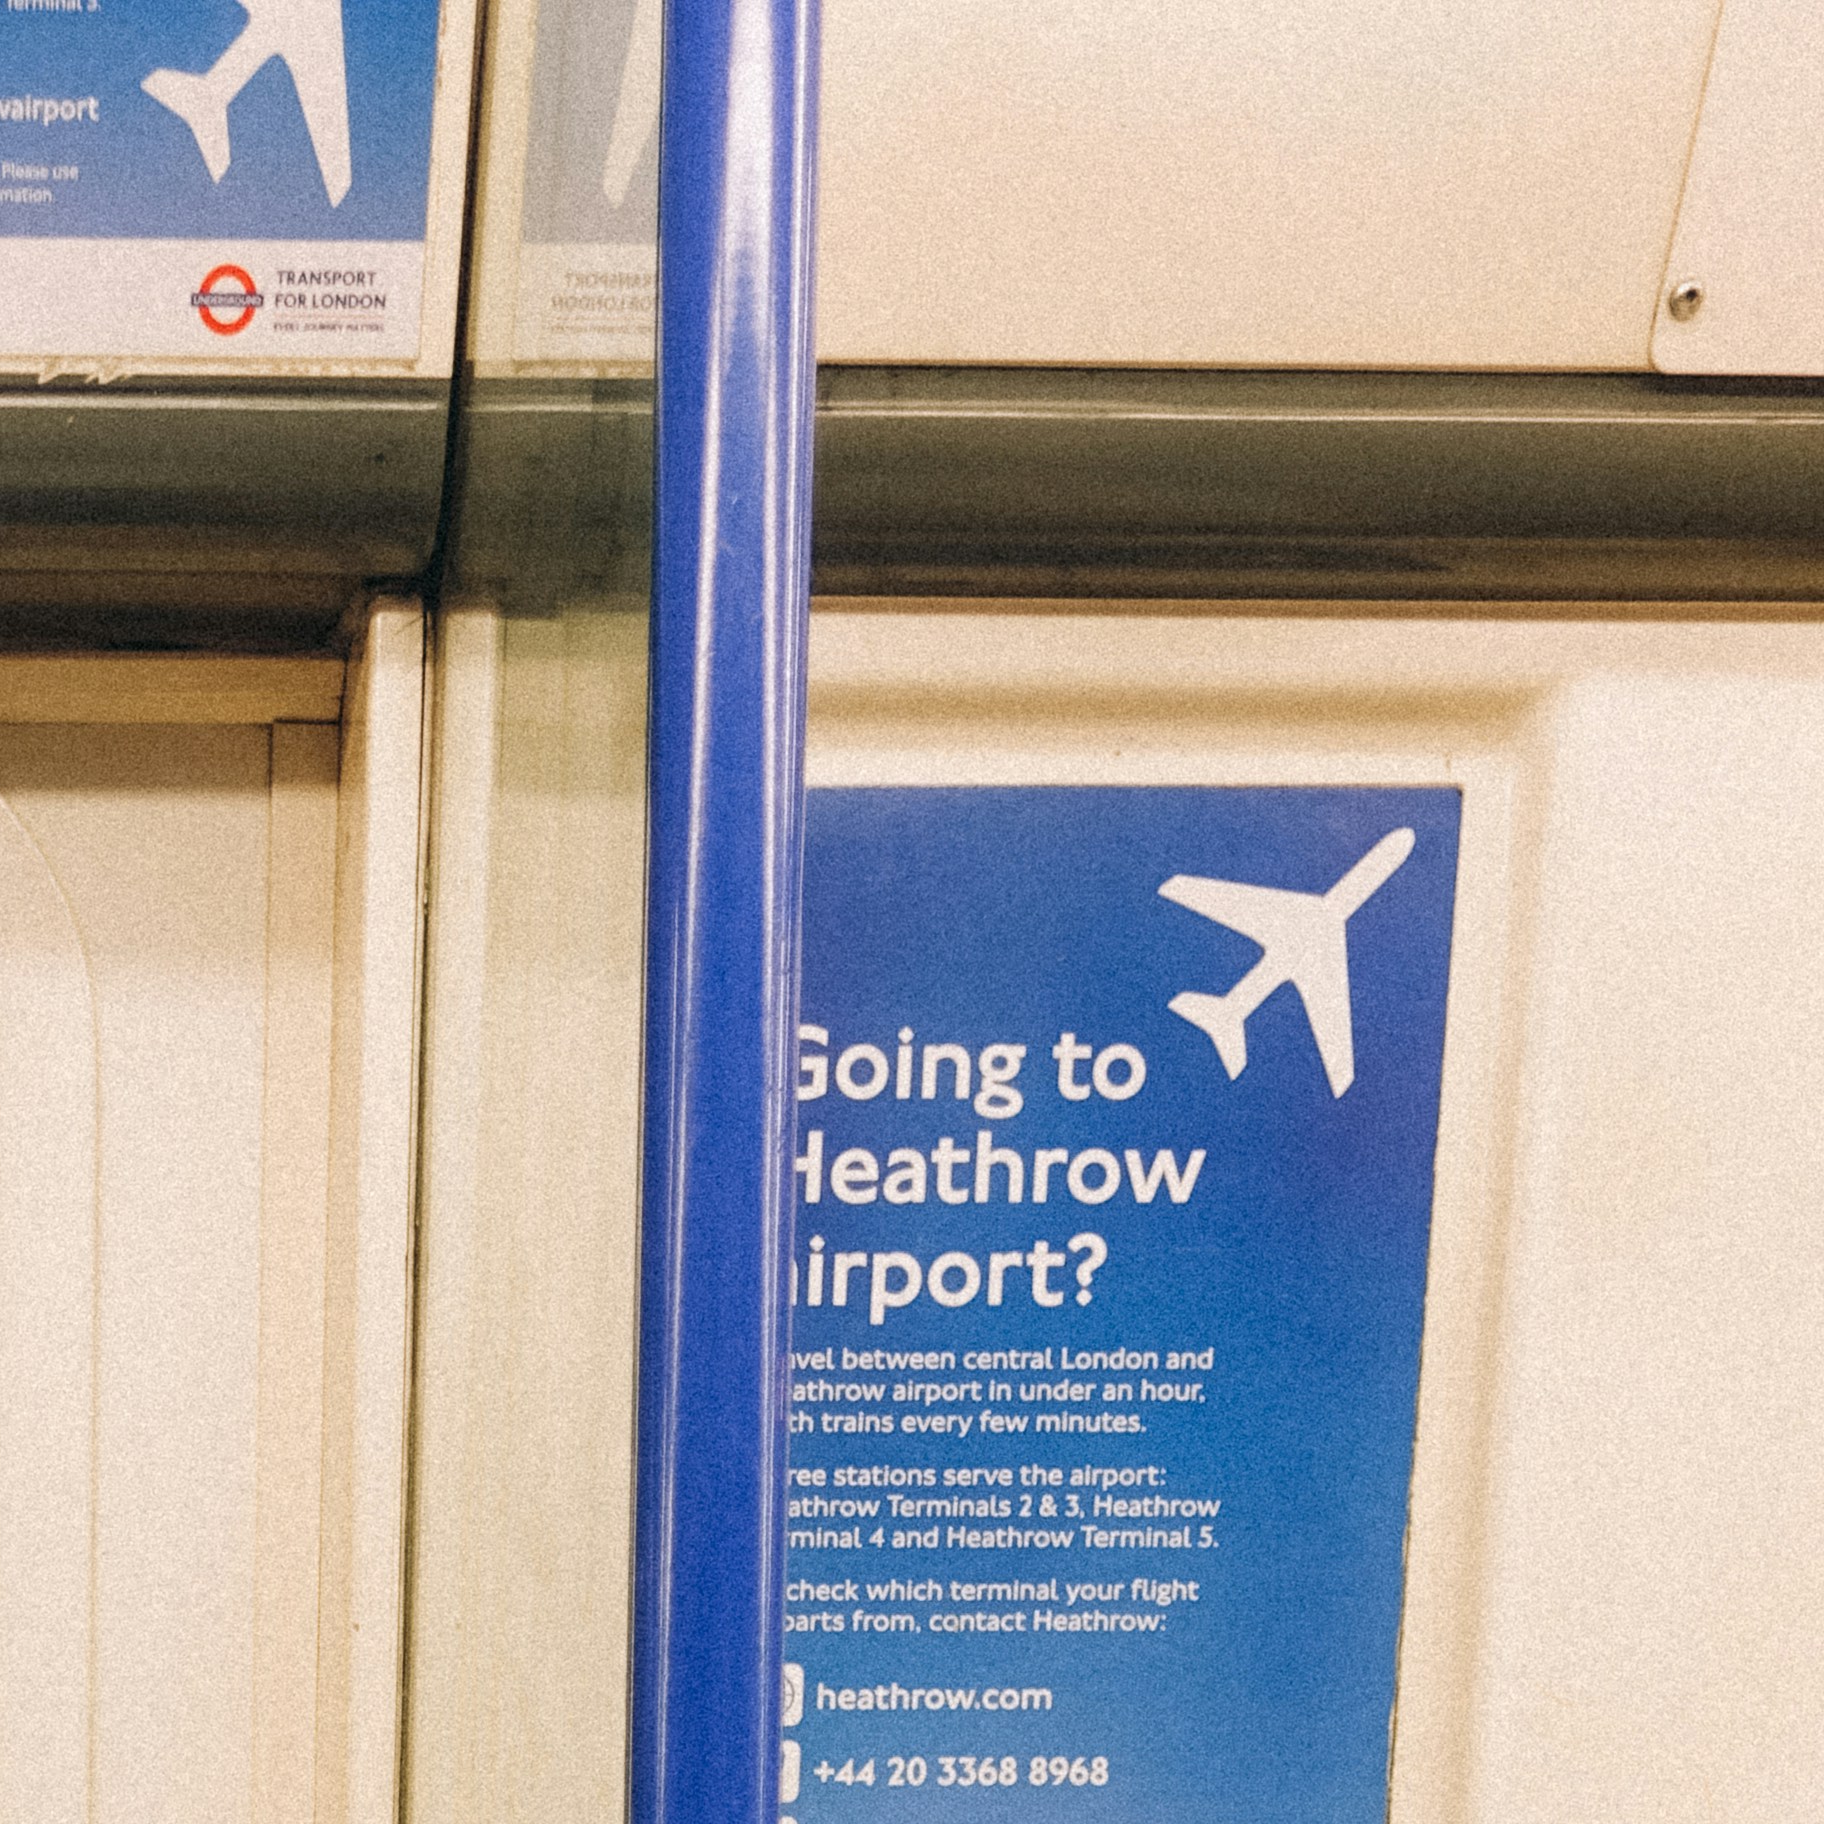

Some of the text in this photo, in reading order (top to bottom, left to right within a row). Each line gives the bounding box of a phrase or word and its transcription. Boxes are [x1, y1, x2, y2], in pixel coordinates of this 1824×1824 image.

[278, 270, 375, 286] TRANSPORT
[275, 293, 386, 309] FOR LONDON
[1053, 1033, 1146, 1100] to
[794, 1233, 1107, 1325] irport?
[842, 1347, 955, 1370] between
[963, 1348, 1053, 1370] central
[1061, 1347, 1158, 1370] London
[1166, 1348, 1214, 1369] and
[792, 1379, 1204, 1406] athrow airport in under an hour,
[821, 1411, 894, 1433] trains
[901, 1415, 973, 1437] every
[979, 1408, 1028, 1433] few
[1036, 1411, 1146, 1433] minutes.
[789, 1464, 1165, 1491] ree stations serve the airport:
[788, 1493, 1220, 1518] athrow Terminals 2 & 3, Heathrow
[869, 1527, 884, 1547] 4
[892, 1526, 939, 1548] and
[947, 1526, 1074, 1548] Heathrow
[1081, 1524, 1191, 1548] Terminal
[1198, 1525, 1218, 1548] 5.
[785, 1578, 1199, 1606] check which terminal your flight
[852, 1609, 920, 1632] from,
[929, 1612, 1026, 1632] contact
[1033, 1610, 1166, 1631] Heathrow:
[817, 1683, 1052, 1710] heathrow.com
[814, 1756, 1108, 1786] +44 20 3368 8968
